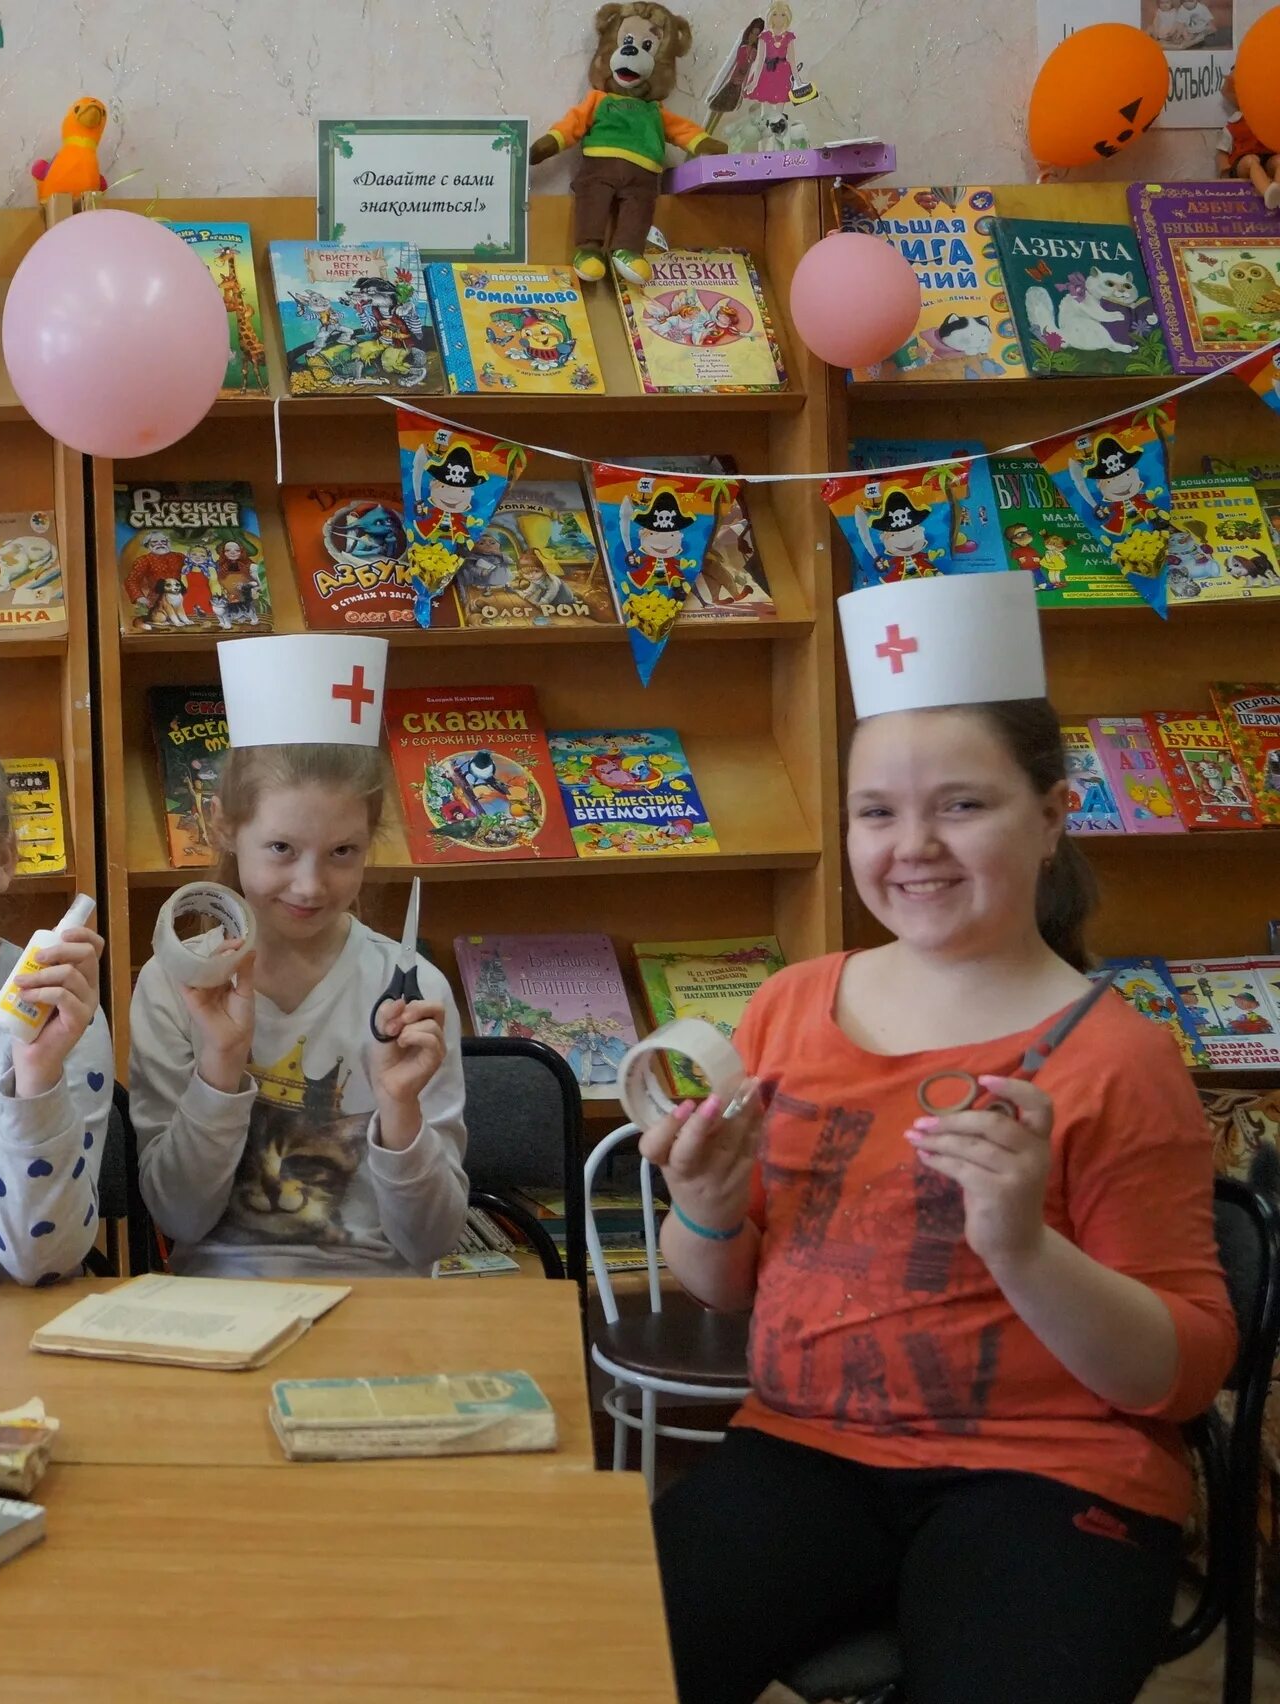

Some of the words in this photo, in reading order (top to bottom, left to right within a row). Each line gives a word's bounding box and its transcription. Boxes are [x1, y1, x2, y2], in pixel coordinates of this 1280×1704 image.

[1164, 55, 1223, 111] остью!»
[352, 170, 436, 187] «Давайте
[440, 175, 449, 186] с
[453, 175, 495, 187] вами
[359, 197, 487, 217] знакомиться!»
[1188, 201, 1260, 214] АЗБУКА
[1011, 235, 1134, 262] АЗБУКА
[320, 254, 372, 262] СВИСТАТЬ
[333, 262, 359, 270] ВСЕХ
[326, 269, 369, 277] НАВЕРХ!
[652, 262, 737, 280] КАЗКИ
[915, 268, 978, 289] НИЙ
[464, 287, 578, 304] РОМАШКОВО
[1181, 477, 1250, 487] ДОШКОЛЬНИКА
[992, 474, 1072, 510] БУКВА
[315, 560, 413, 598] АЗБУК
[340, 591, 378, 607] СТИХАХ
[388, 609, 416, 622] РО
[540, 600, 591, 618] РОЙ
[1232, 695, 1280, 713] ПЕРВА
[168, 718, 229, 746] ВЕСЁЛ
[1163, 720, 1224, 732] ВЕСЁЛ
[412, 735, 464, 747] СОРОКИ
[1167, 733, 1232, 748] БУКВА
[573, 804, 700, 821] БЕГЕМОТИКА
[520, 979, 622, 995] ПРИНЦЕССЫ
[705, 982, 763, 991] ПРИКЛЮЧЕНИ
[683, 992, 719, 1000] НАТАШИ
[1207, 1049, 1279, 1057] ОРОЖНОГО
[1209, 1055, 1280, 1065] ВИЖЕНИЯ
